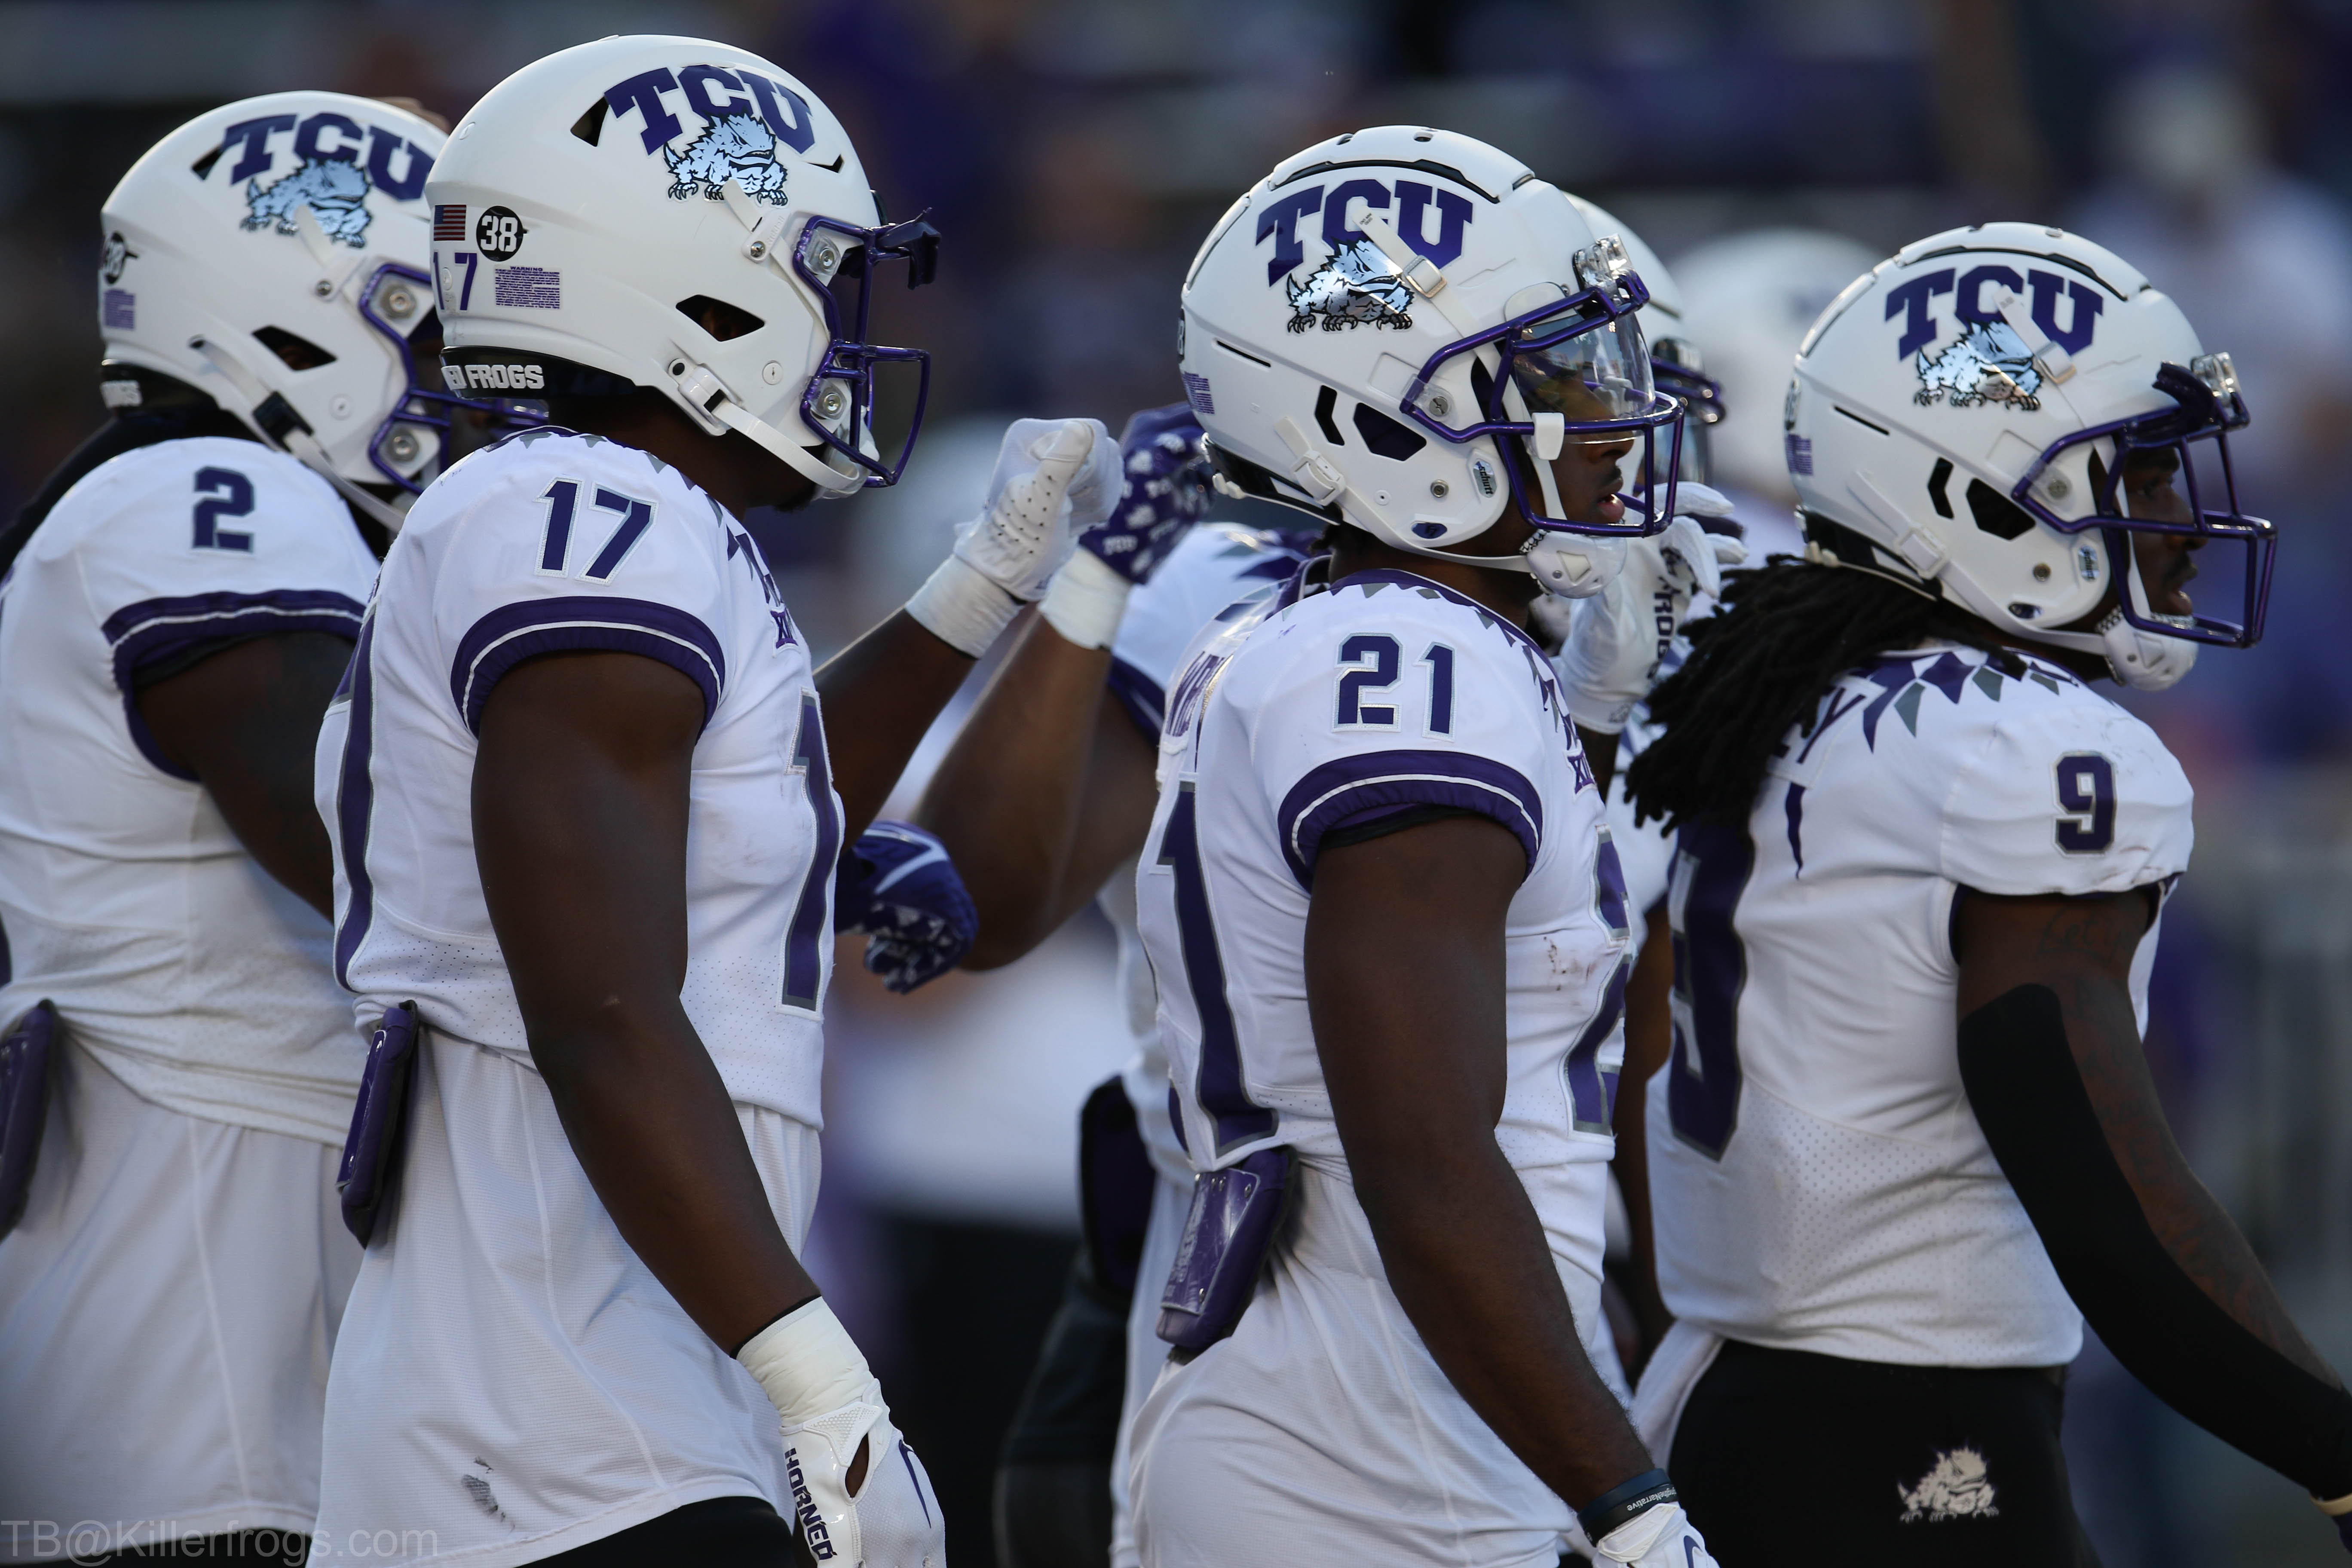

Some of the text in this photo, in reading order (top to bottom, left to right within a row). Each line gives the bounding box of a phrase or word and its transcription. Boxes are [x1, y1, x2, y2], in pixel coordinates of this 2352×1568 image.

[604, 64, 815, 155] TCU
[219, 112, 435, 202] TCU
[480, 215, 518, 252] 38
[1256, 179, 1473, 287] TCU
[1884, 265, 2104, 361] TCU
[465, 364, 545, 389] FROGS
[192, 466, 254, 553] 2
[1479, 466, 1494, 495] schutt
[533, 477, 658, 586] 17
[1332, 632, 1456, 742] 21
[2052, 750, 2117, 858] 9
[784, 1447, 836, 1560] HORNED
